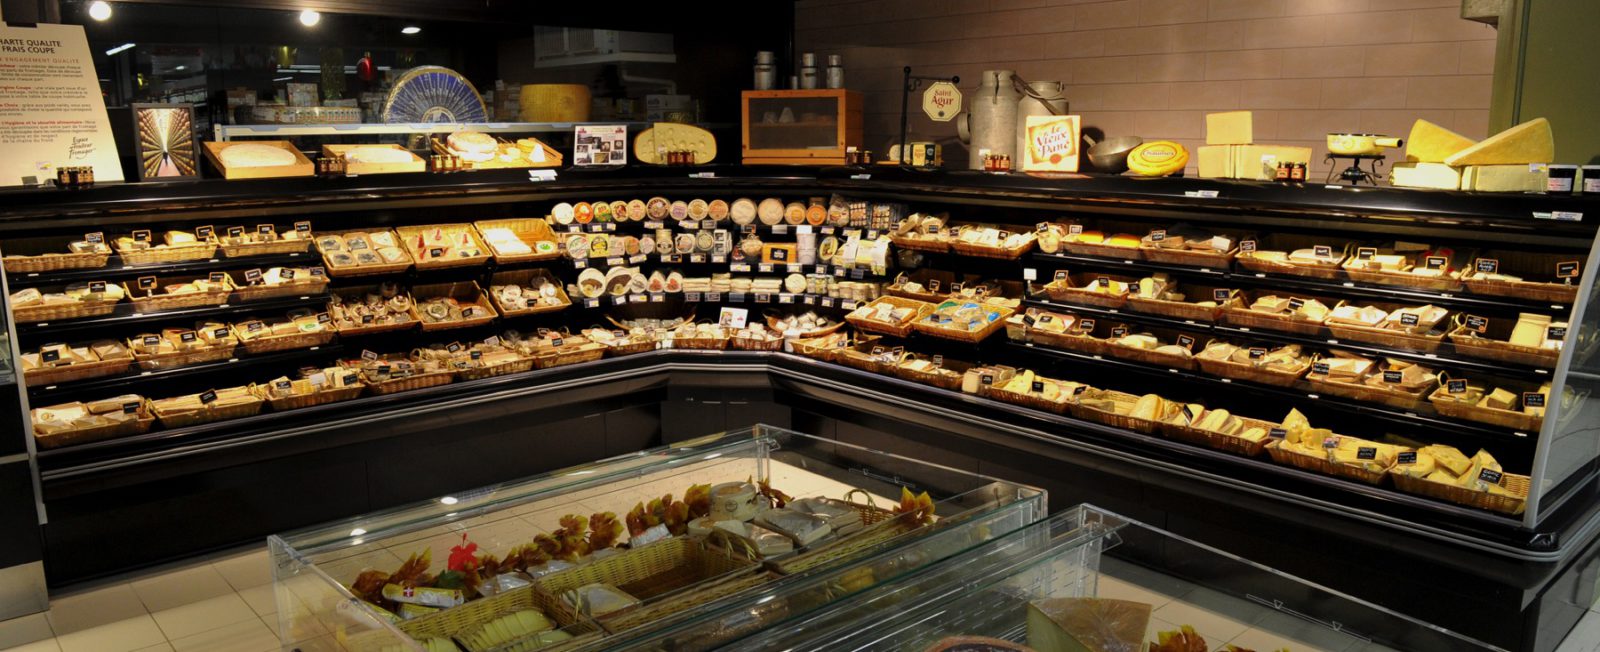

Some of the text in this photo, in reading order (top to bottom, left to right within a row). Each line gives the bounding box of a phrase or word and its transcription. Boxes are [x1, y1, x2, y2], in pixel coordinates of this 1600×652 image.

[26, 39, 62, 47] QUALITE
[27, 46, 56, 54] COUPE
[931, 95, 954, 108] Agur
[1036, 131, 1067, 146] Vieux
